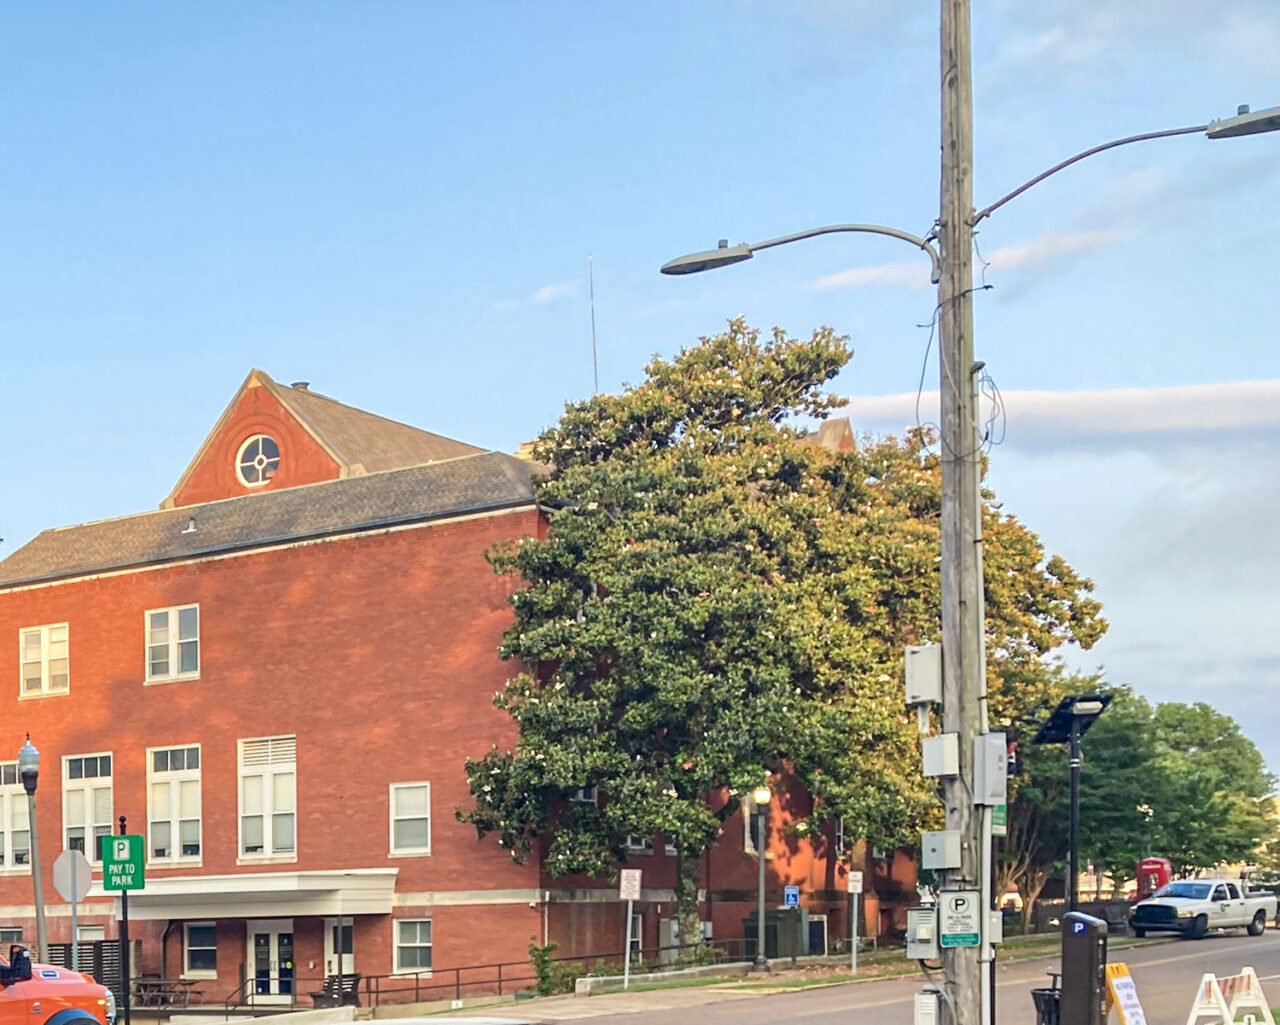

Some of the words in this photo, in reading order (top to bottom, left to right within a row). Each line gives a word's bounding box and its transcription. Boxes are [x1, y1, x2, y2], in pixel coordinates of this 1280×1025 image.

[117, 842, 126, 858] P
[109, 864, 123, 874] PAY
[124, 864, 135, 874] TO
[111, 876, 133, 886] PARK
[955, 899, 965, 911] P
[1074, 922, 1084, 933] P
